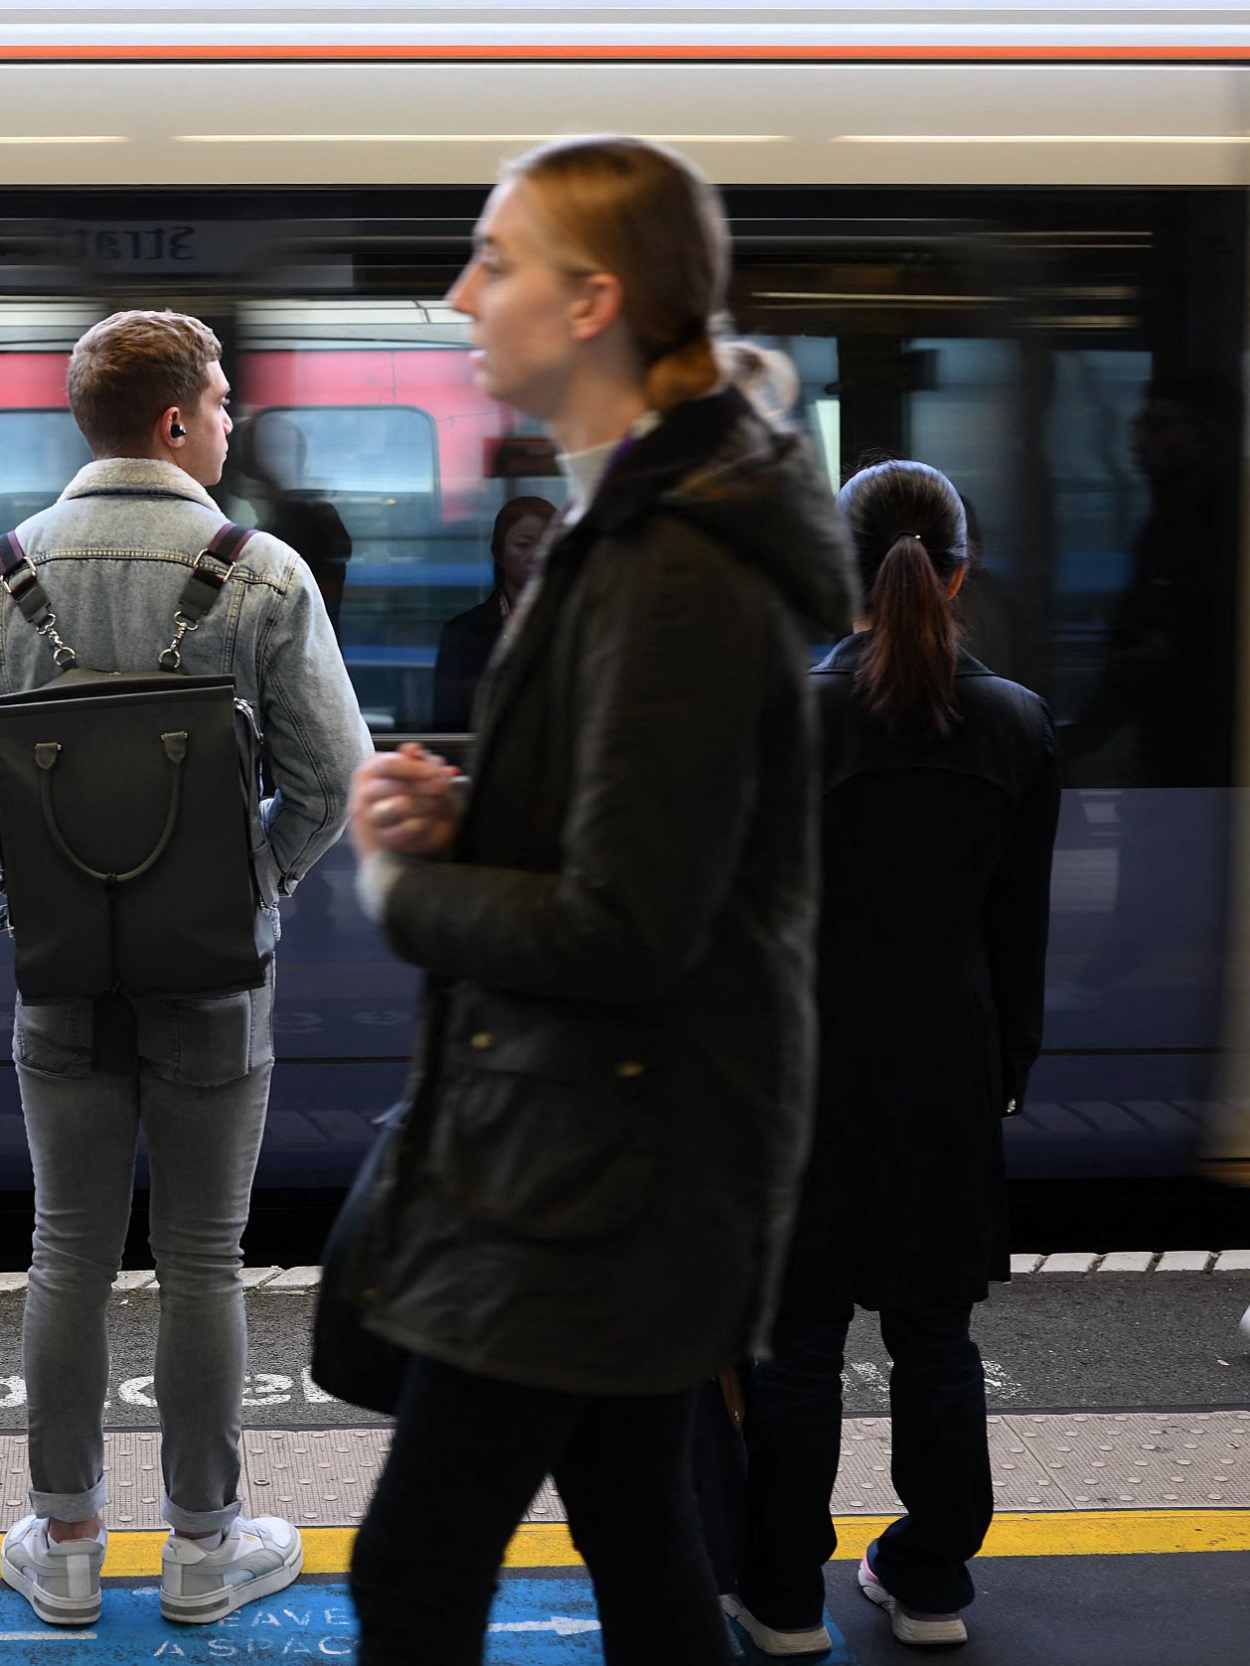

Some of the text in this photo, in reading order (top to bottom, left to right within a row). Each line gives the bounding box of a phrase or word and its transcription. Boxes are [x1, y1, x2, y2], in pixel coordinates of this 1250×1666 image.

[204, 1608, 350, 1628] EAVE
[154, 1636, 358, 1657] A SPAC
